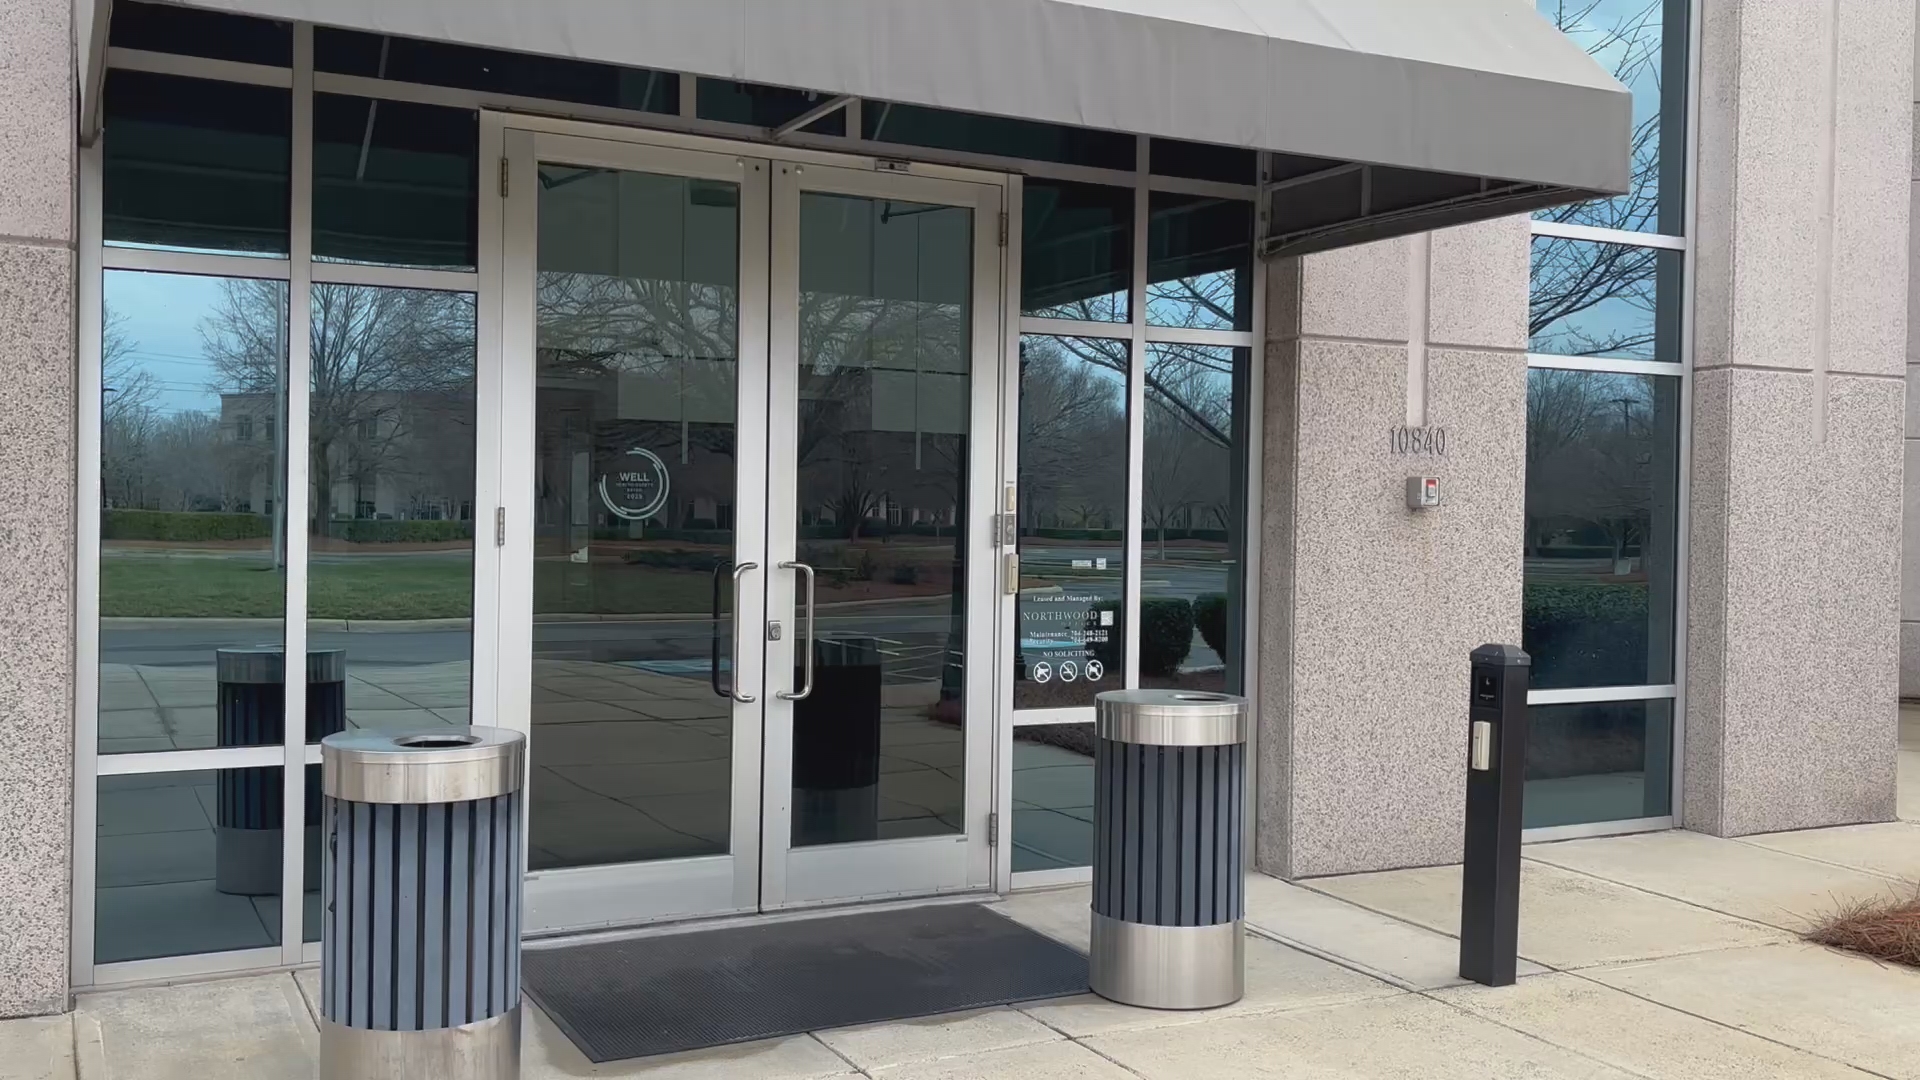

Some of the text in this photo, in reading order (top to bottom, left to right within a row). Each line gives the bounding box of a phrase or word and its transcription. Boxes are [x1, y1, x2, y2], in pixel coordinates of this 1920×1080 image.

[1390, 425, 1445, 455] 10840
[619, 472, 650, 482] WELL
[1066, 595, 1092, 603] Managed
[1023, 611, 1098, 621] NORTHWOOD
